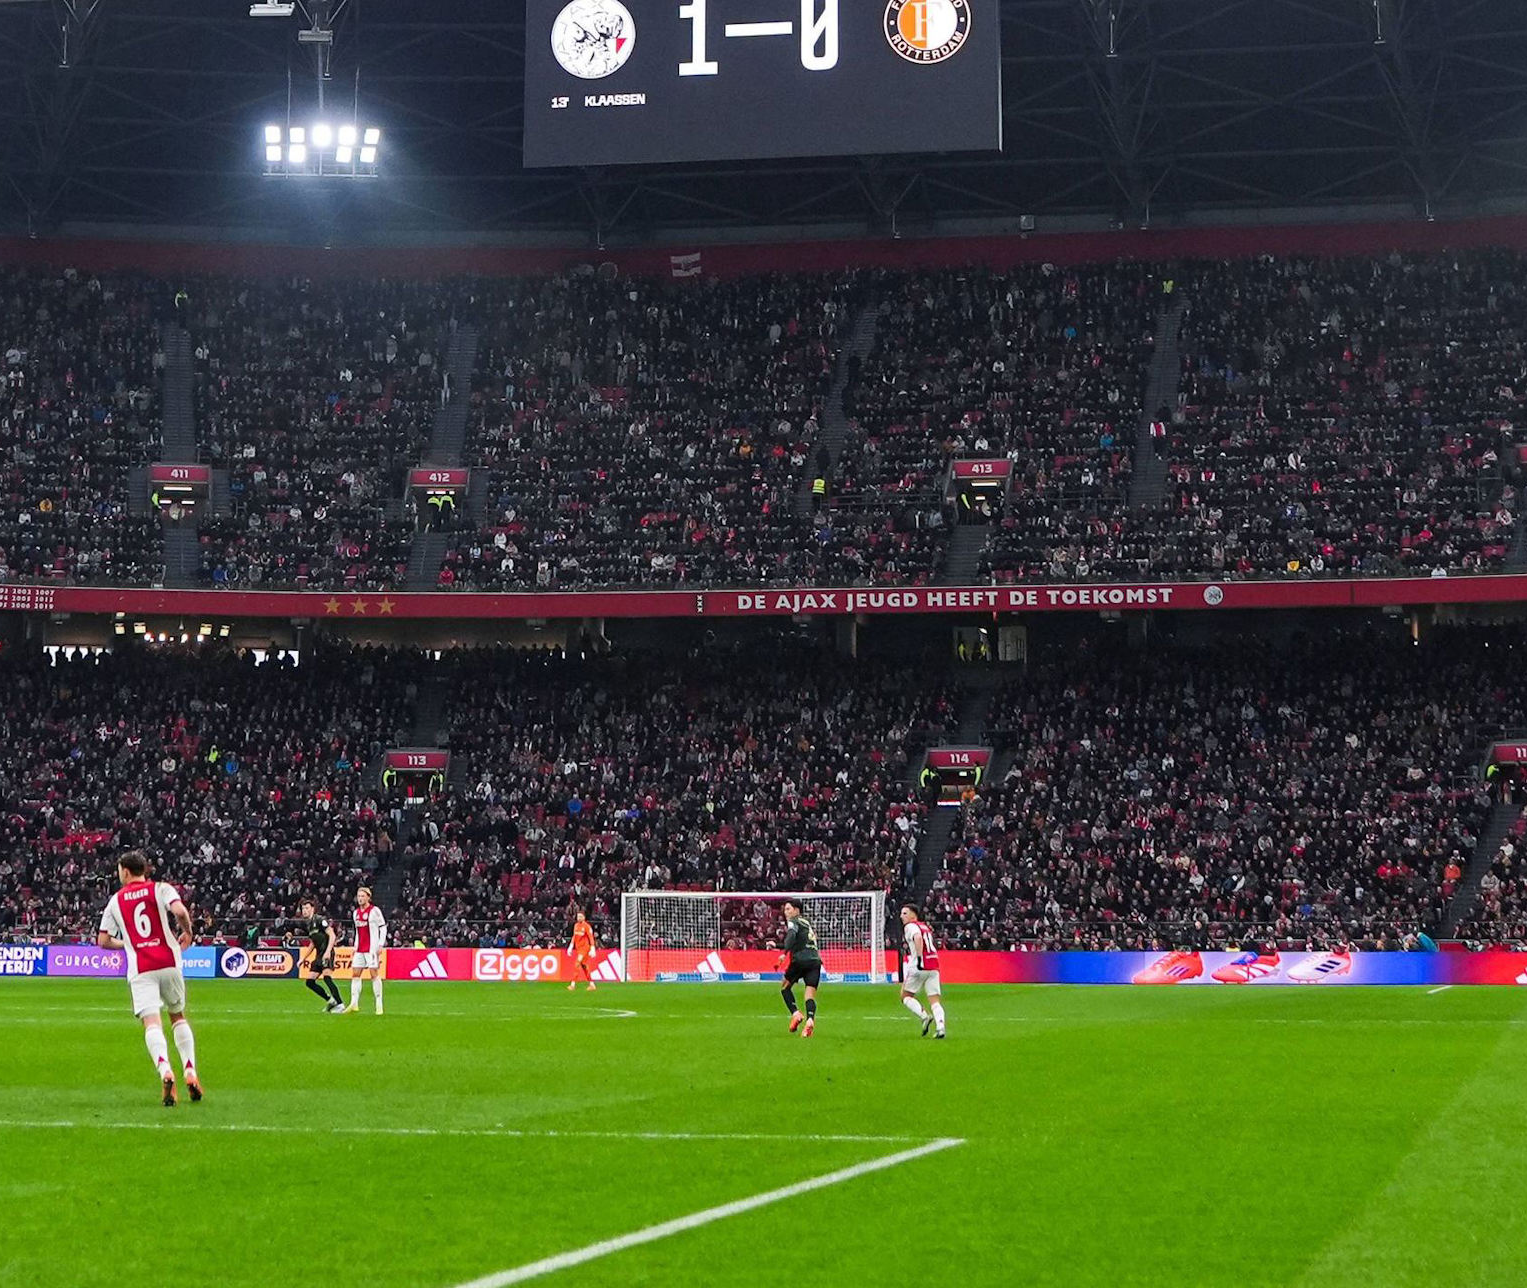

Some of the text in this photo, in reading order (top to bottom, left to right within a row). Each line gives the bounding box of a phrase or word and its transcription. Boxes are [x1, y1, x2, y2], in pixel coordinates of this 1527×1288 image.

[891, 31, 964, 60] ROTTERDAM
[585, 93, 645, 107] KLAASSEN
[171, 469, 188, 478] 411
[971, 464, 993, 473] 413
[429, 473, 450, 483] 412
[737, 588, 1172, 612] DE AJAX JEUGD HEEFT DE TOEKOMST
[408, 756, 426, 765] 113
[950, 753, 970, 763] 114
[134, 901, 151, 938] 6
[54, 953, 121, 969] CURAÇAO
[254, 954, 283, 963] ALLSAFE
[475, 948, 558, 980] Ziggo
